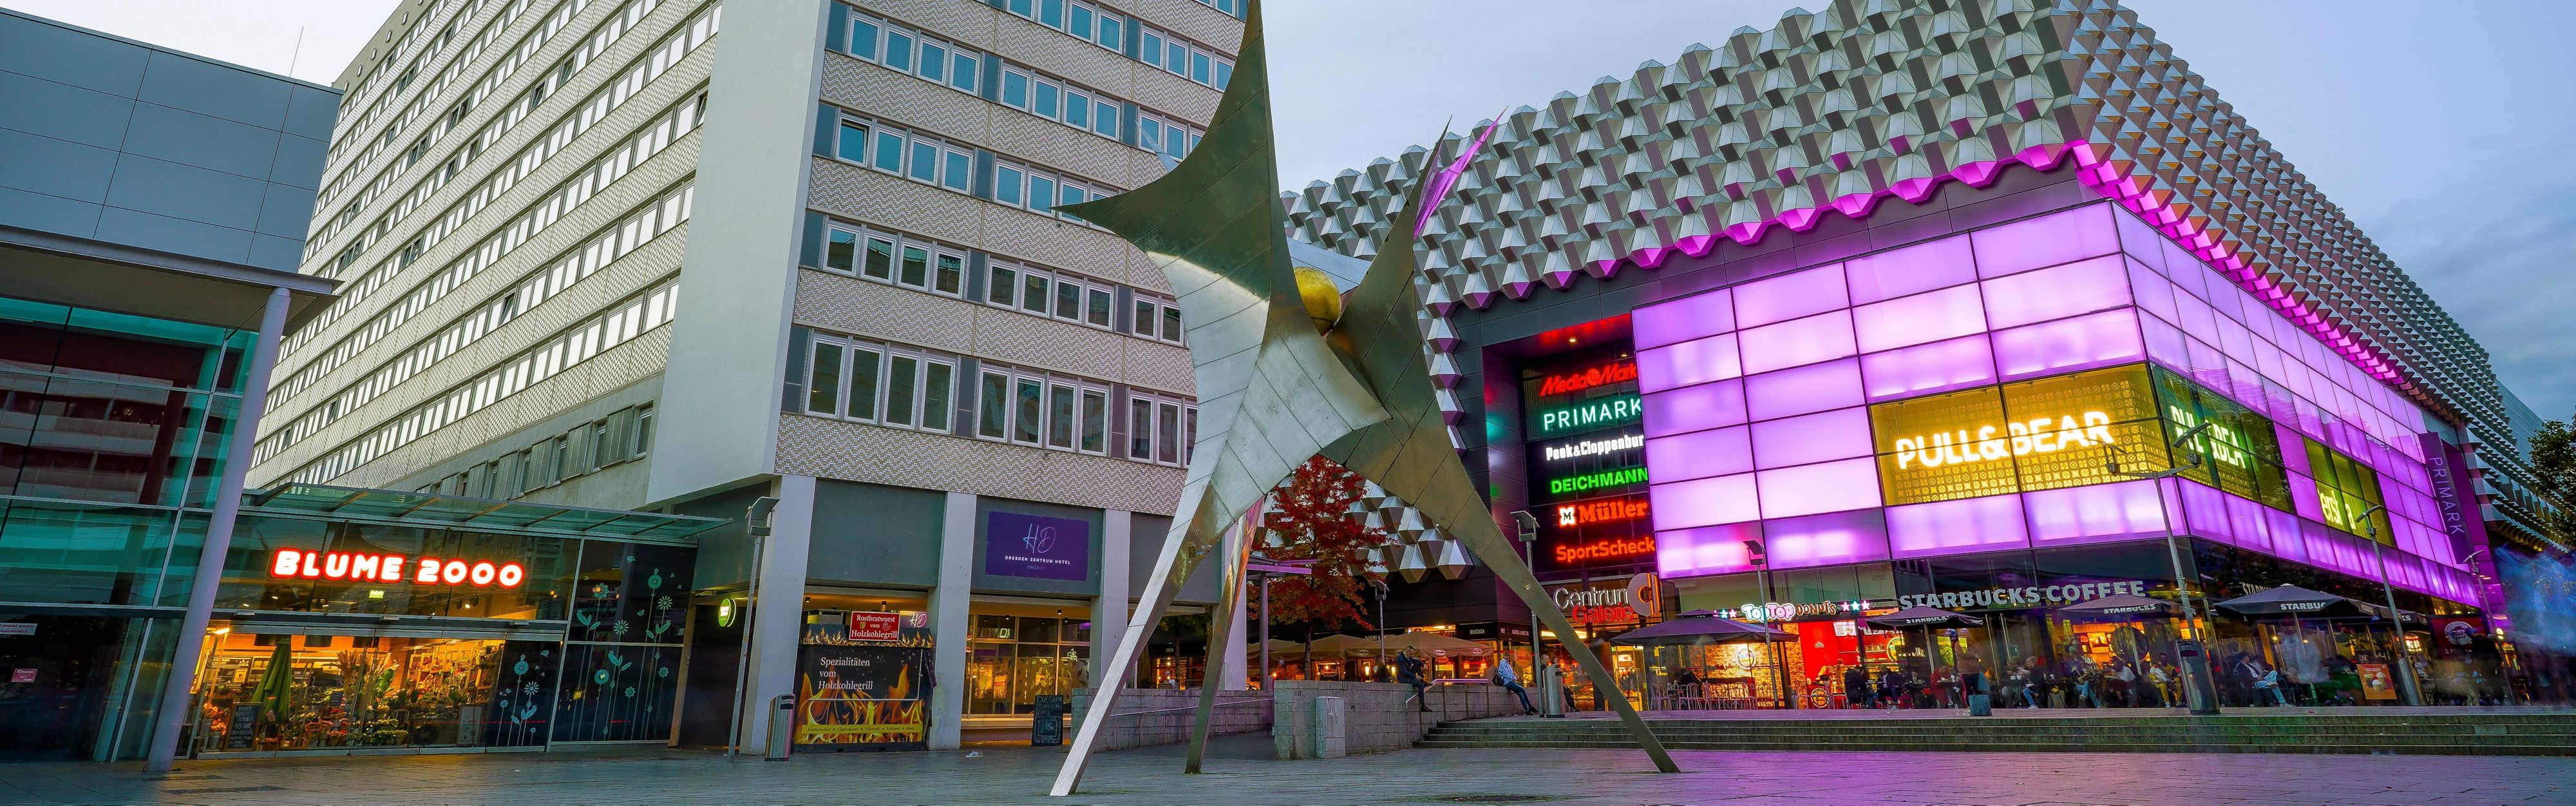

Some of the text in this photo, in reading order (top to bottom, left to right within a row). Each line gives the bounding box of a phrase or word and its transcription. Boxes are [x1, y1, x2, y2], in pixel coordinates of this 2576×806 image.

[1539, 363, 1637, 396] MediaMark
[1544, 398, 1642, 431] PRIMARK
[1546, 434, 1644, 461] Peek&Cloppenbur
[1896, 410, 2116, 470] PULL&BEAR
[1551, 467, 1648, 494] DEICHMANN
[2429, 457, 2465, 534] PRIMARK
[1578, 501, 1648, 523] Müller
[1556, 537, 1656, 562] SportScheck
[271, 547, 526, 589] BLUME 2000
[1554, 586, 1628, 609] Centrum
[1795, 600, 1836, 616] DONUTS
[1900, 581, 2144, 611] STARBUCKS COFFEE
[2280, 602, 2326, 610] STARBU
[1572, 601, 1634, 625] Galerie
[2103, 604, 2156, 614] STARBUCKS
[851, 629, 898, 639] Holzkohlegrill
[820, 657, 870, 667] Spezialitäten
[818, 680, 873, 691] Holzkohlegrill
